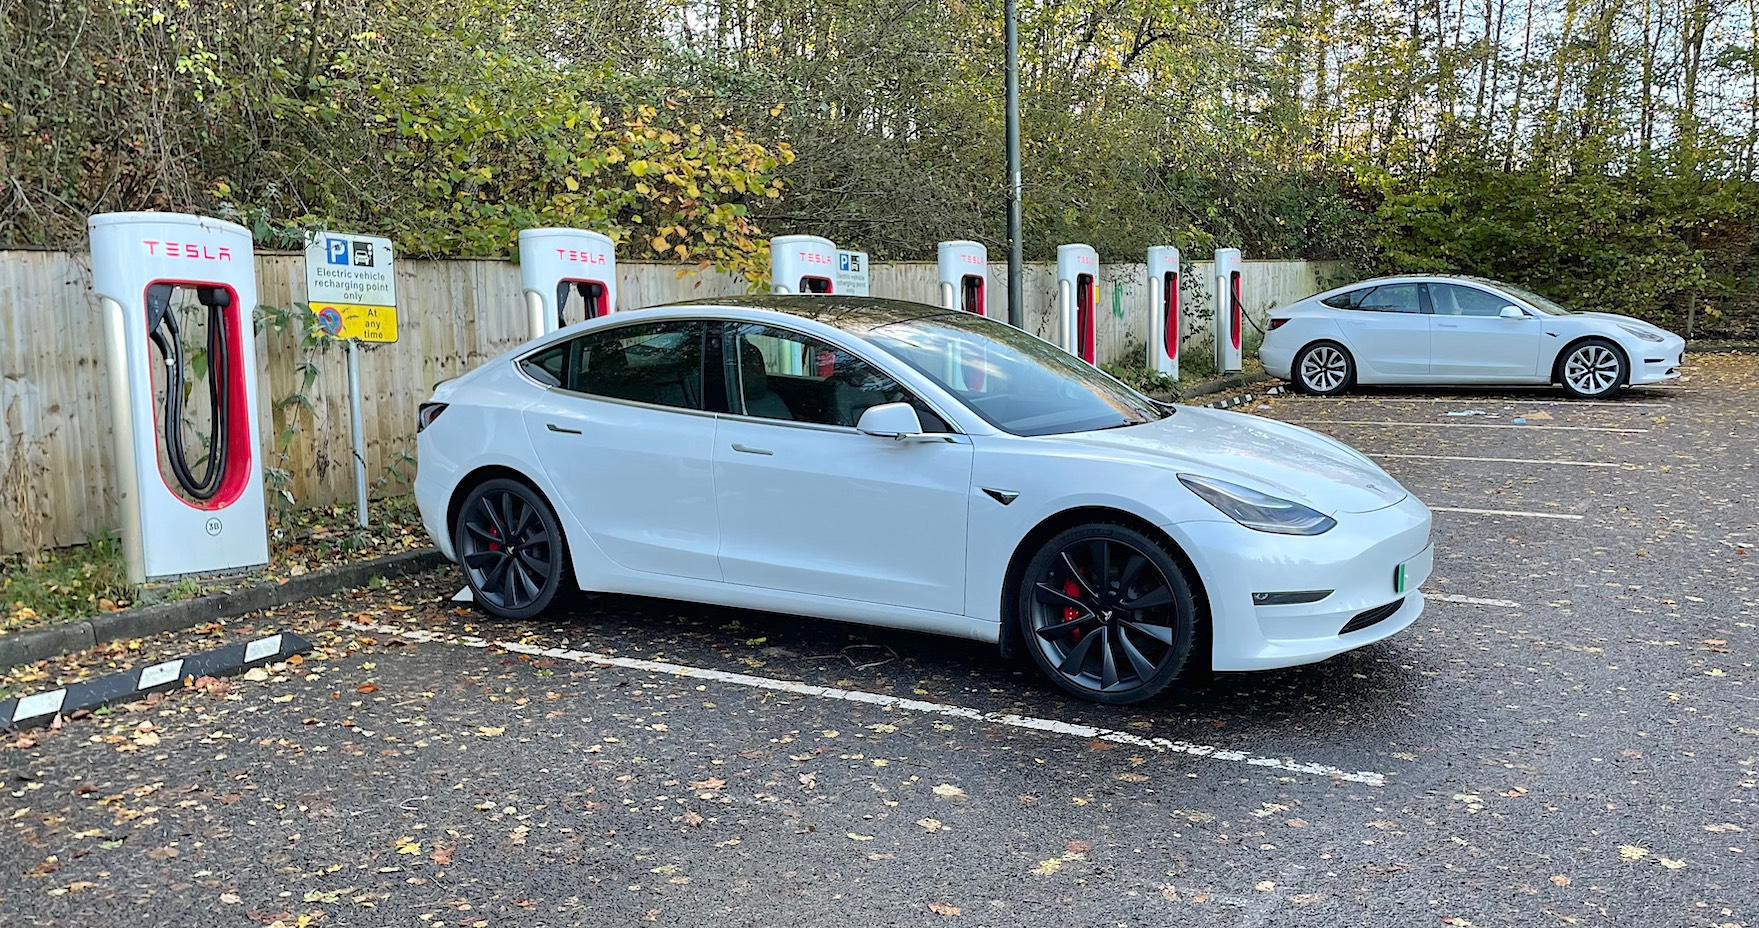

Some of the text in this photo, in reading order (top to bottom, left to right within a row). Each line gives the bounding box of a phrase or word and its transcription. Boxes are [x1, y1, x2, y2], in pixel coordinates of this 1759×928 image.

[143, 240, 231, 262] TESLA
[330, 240, 345, 263] P
[556, 249, 606, 265] TESLA
[800, 252, 832, 265] TESLA
[316, 267, 385, 281] Electric vehicle
[314, 278, 388, 292] recharging point
[344, 292, 363, 302] only
[367, 308, 377, 317] At
[365, 320, 381, 330] any
[364, 330, 383, 339] time
